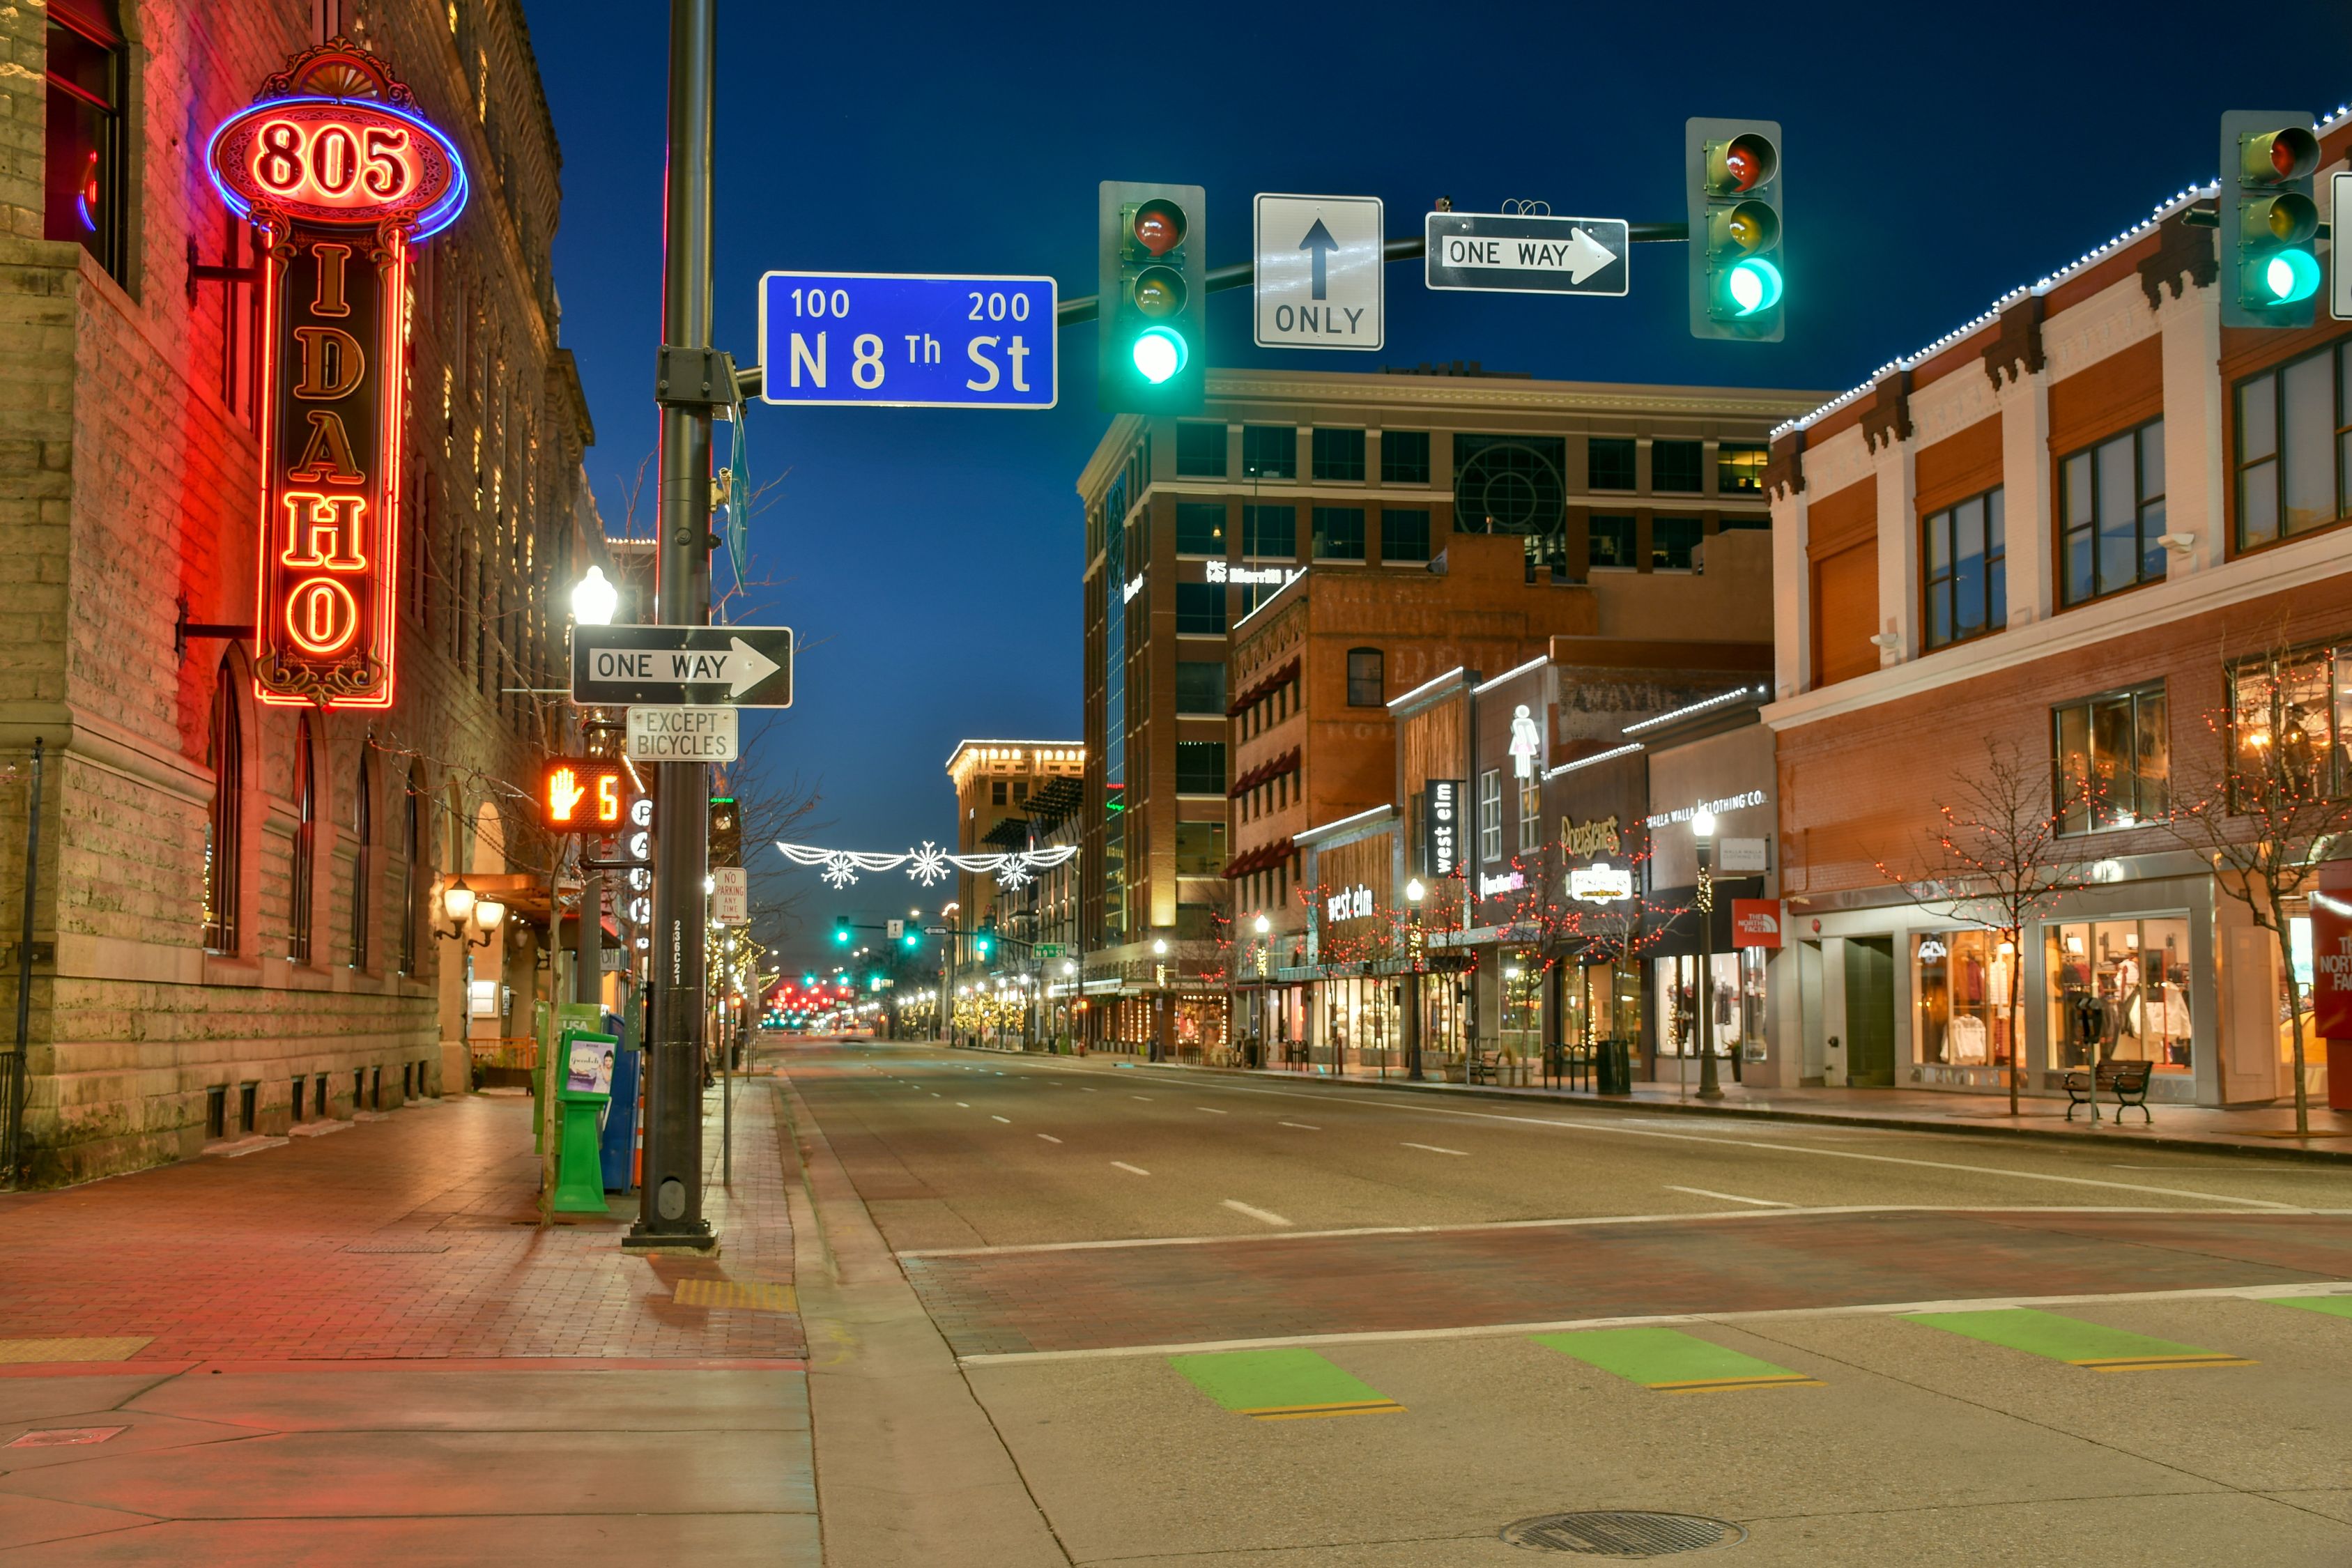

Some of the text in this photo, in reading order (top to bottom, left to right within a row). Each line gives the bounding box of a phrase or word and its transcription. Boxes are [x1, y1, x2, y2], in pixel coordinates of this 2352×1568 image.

[252, 118, 411, 202] 805
[1450, 240, 1569, 266] ONE WAY
[790, 289, 1030, 322] 100 200
[1275, 305, 1364, 335] ONLY
[790, 332, 1030, 392] N 8 Th St
[280, 241, 367, 654] IDAHO
[597, 653, 728, 679] ONE WAY
[647, 712, 718, 732] EXCEPT
[637, 736, 726, 755] BICYCLES
[599, 775, 618, 821] 6
[1670, 807, 1694, 823] WALLA
[1434, 784, 1452, 873] west elm
[717, 886, 744, 896] PARKING
[725, 873, 736, 884] NO
[1328, 883, 1372, 922] west elm
[2320, 955, 2352, 973] NOR
[562, 1020, 589, 1031] USA
